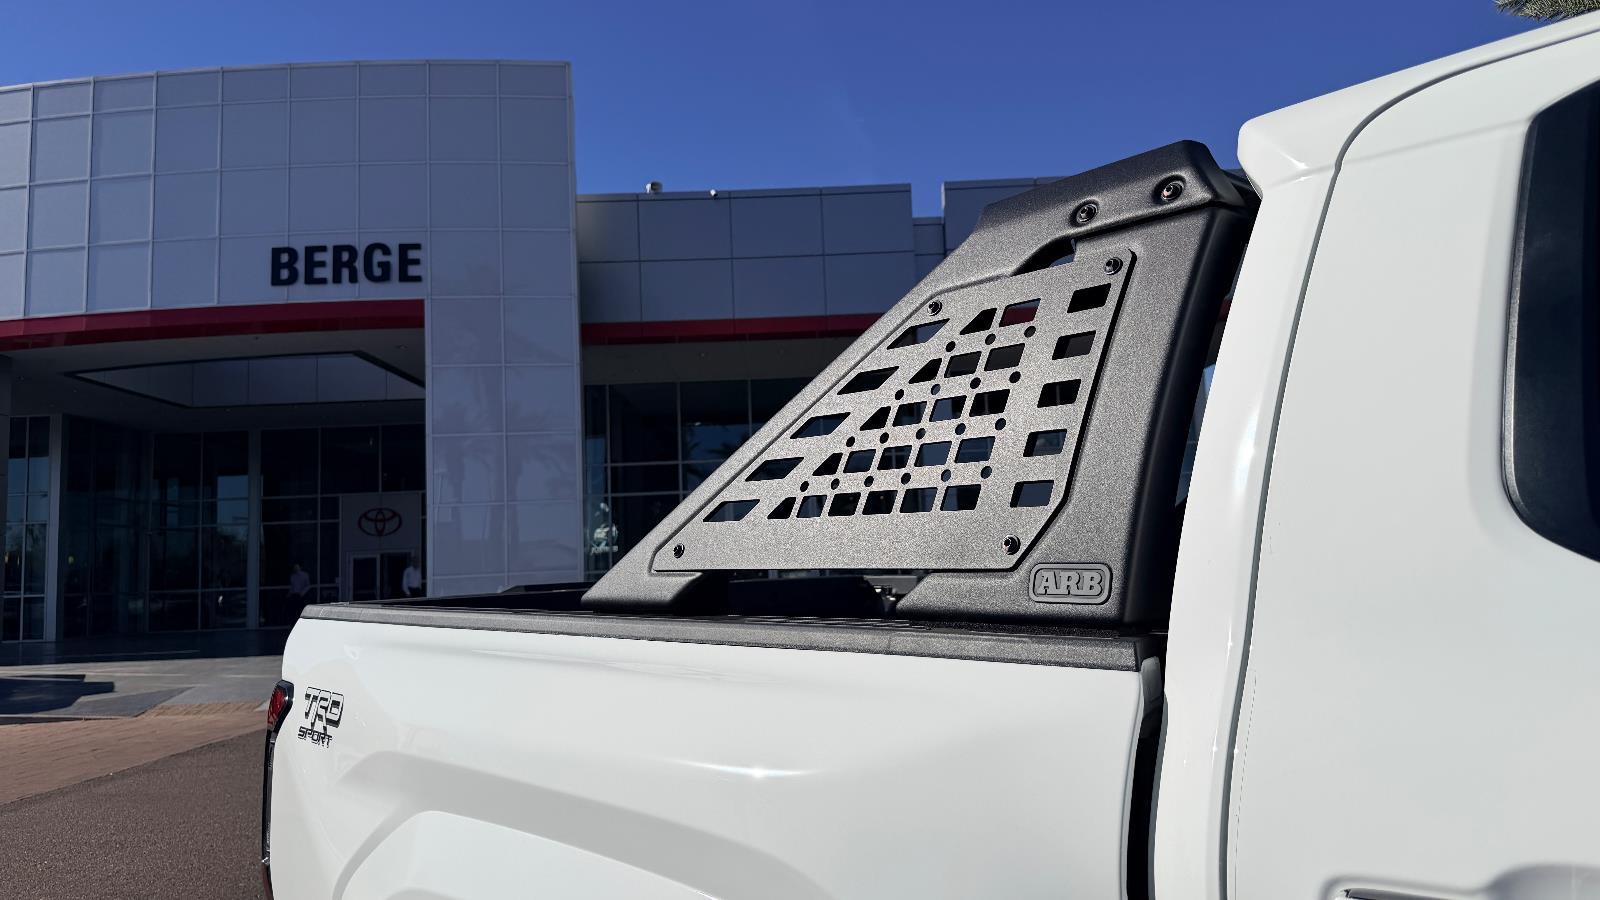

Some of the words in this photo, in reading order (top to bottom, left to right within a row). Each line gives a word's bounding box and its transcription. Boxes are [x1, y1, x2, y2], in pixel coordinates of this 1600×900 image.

[270, 242, 422, 287] BERGE
[1035, 569, 1103, 596] ARB
[304, 686, 344, 734] TRD
[298, 725, 333, 749] SPORT
